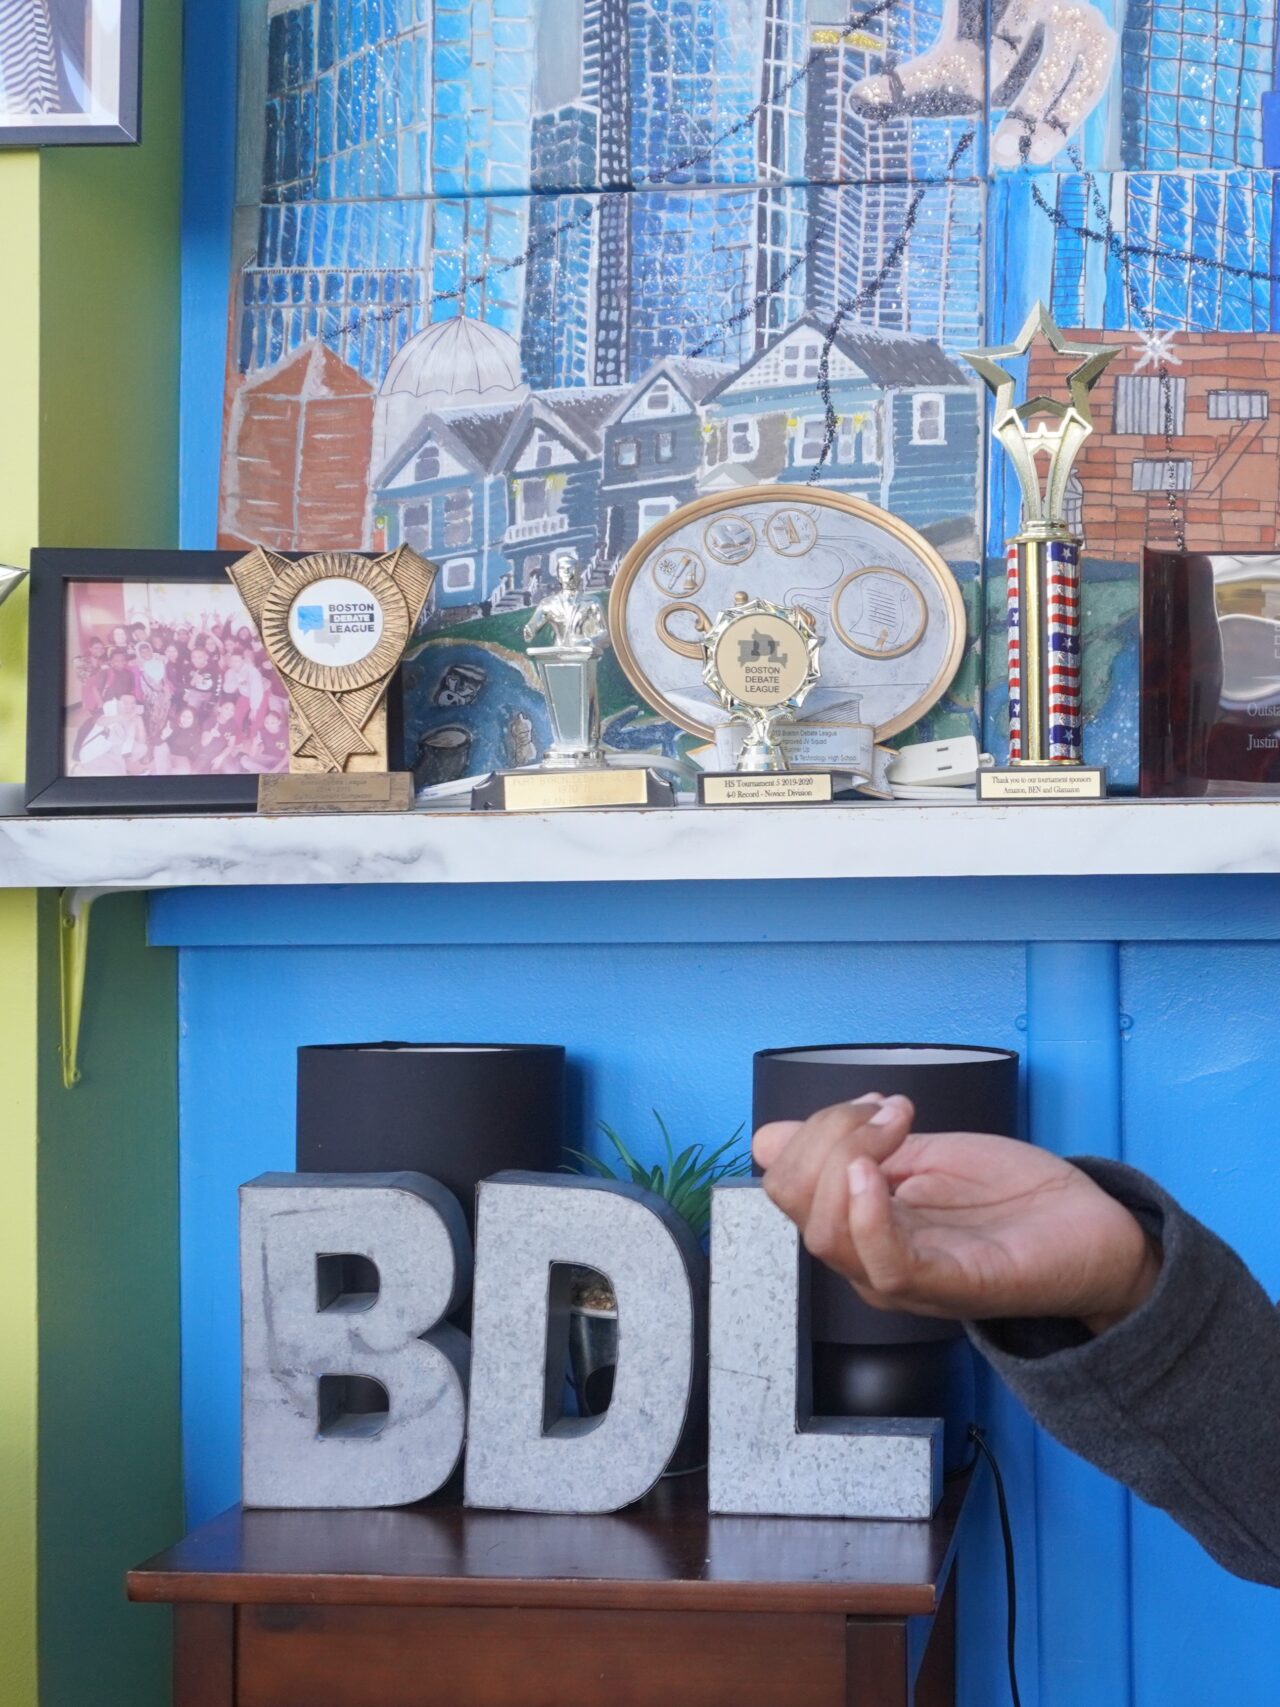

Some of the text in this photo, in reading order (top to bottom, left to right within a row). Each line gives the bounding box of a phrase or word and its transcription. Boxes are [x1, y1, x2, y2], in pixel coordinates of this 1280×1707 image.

[328, 603, 375, 613] BOSTON
[333, 613, 371, 622] DEBATE
[329, 624, 375, 633] LEAGUE
[745, 666, 780, 674] BOSTON
[745, 676, 780, 684] DEBATE
[745, 685, 780, 693] LEAGUE
[819, 730, 837, 738] League
[1246, 734, 1278, 751] Justin
[724, 780, 735, 788] HS
[736, 779, 774, 788] Tournament
[782, 777, 814, 786] 2019-2020
[992, 776, 1009, 784] Thank
[1010, 777, 1020, 785] you
[1069, 777, 1092, 785] sponsors
[726, 790, 736, 798] 4-0
[737, 789, 760, 798] Record
[764, 789, 787, 797] Novice
[787, 788, 813, 796] Division
[1003, 787, 1027, 795] Amazon,
[240, 1172, 944, 1521] BDL
